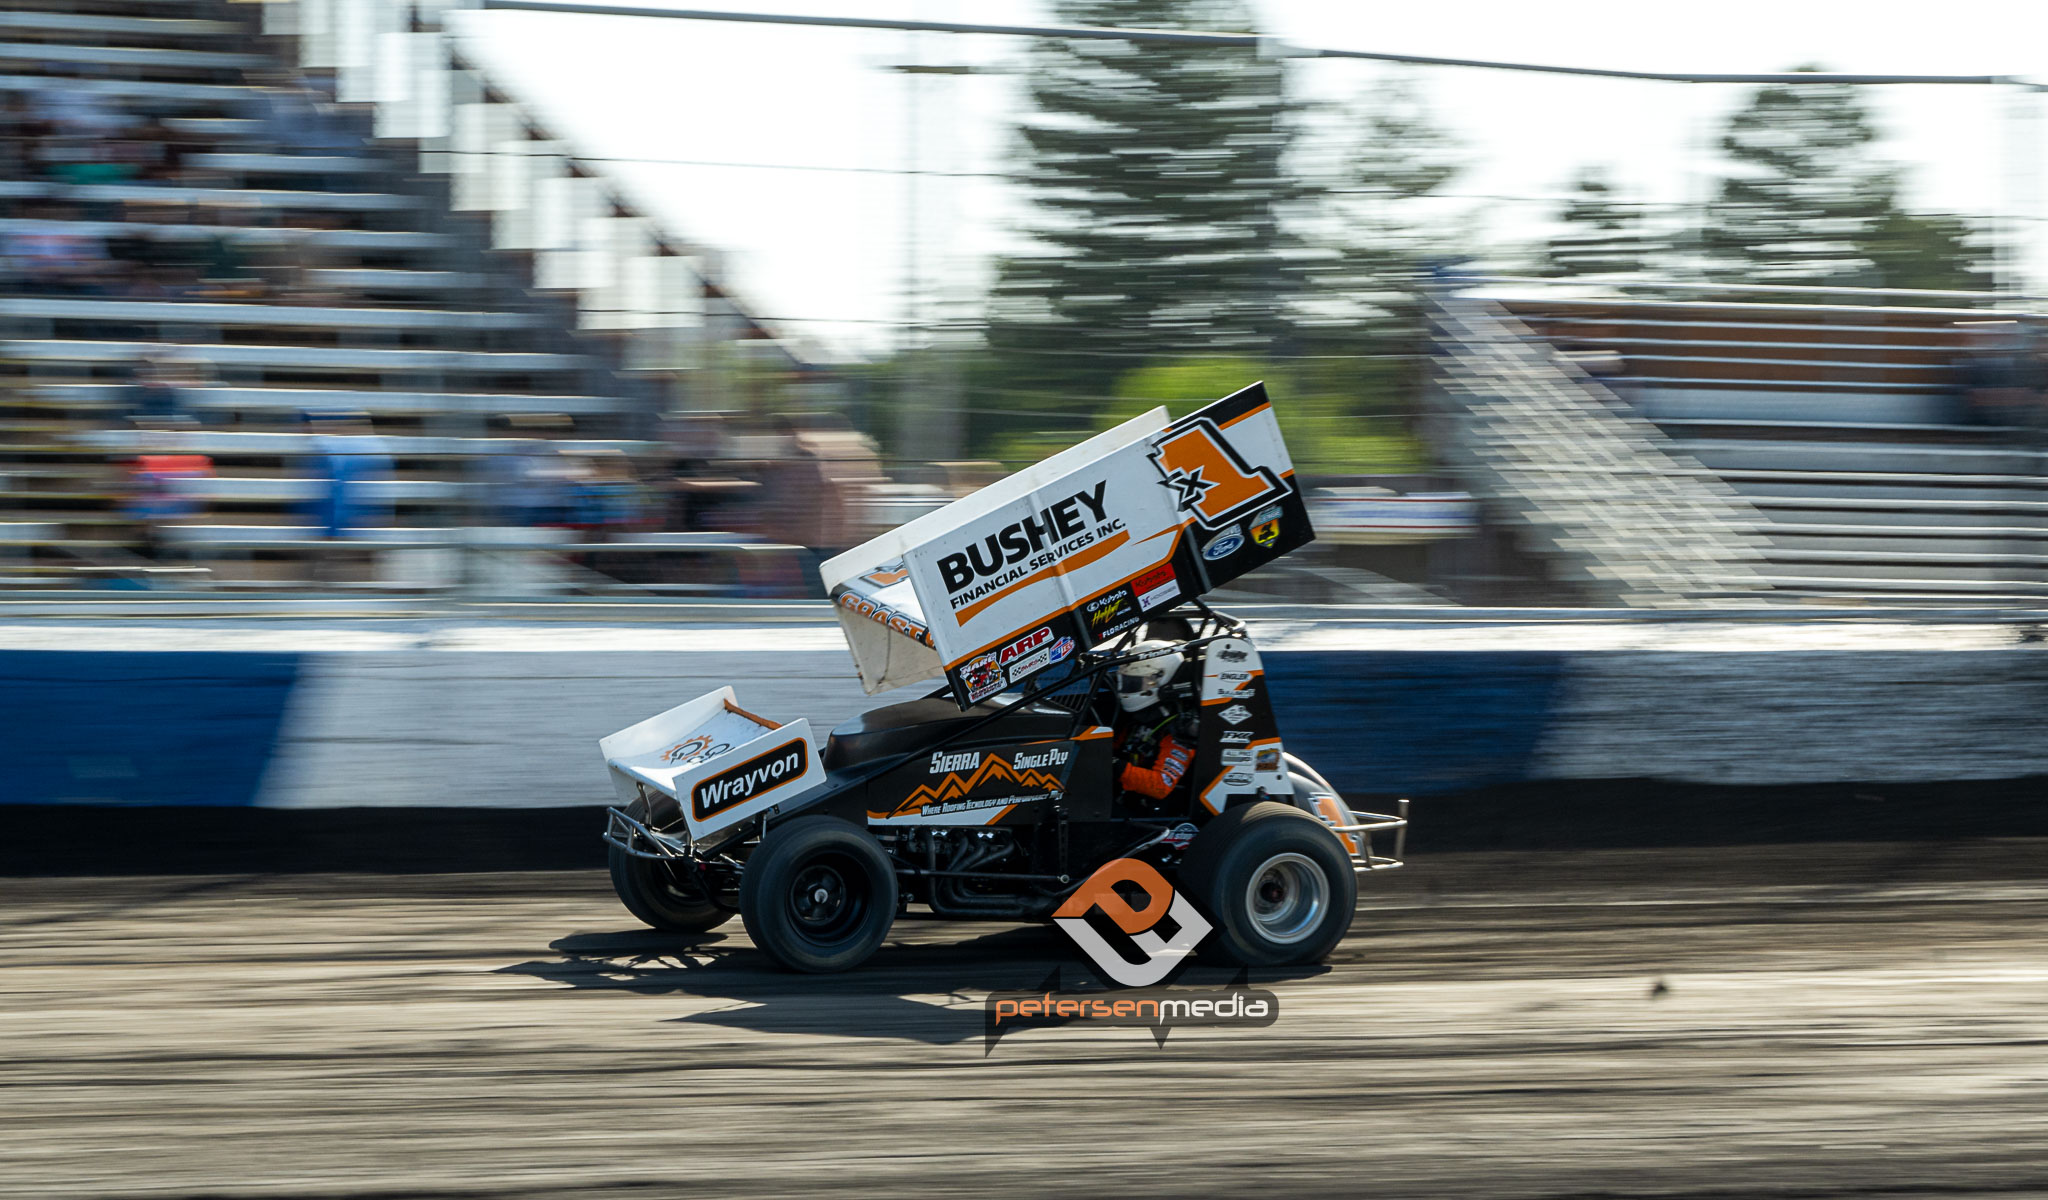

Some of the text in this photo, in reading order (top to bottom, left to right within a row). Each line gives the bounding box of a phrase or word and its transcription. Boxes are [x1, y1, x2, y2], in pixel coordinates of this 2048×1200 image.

[937, 480, 1107, 594] BUSHEY
[1213, 540, 1238, 556] Ford
[950, 518, 1126, 609] FINANCIAL SERVICES INC.
[1099, 589, 1127, 605] Kubota
[839, 591, 927, 641] COAST
[1001, 628, 1050, 664] ARP
[930, 752, 980, 774] SIERRA
[1013, 748, 1069, 770] SINGLE PLY
[701, 752, 799, 809] Wrayvon
[922, 804, 942, 816] WHERE
[942, 801, 966, 814] ROOFING
